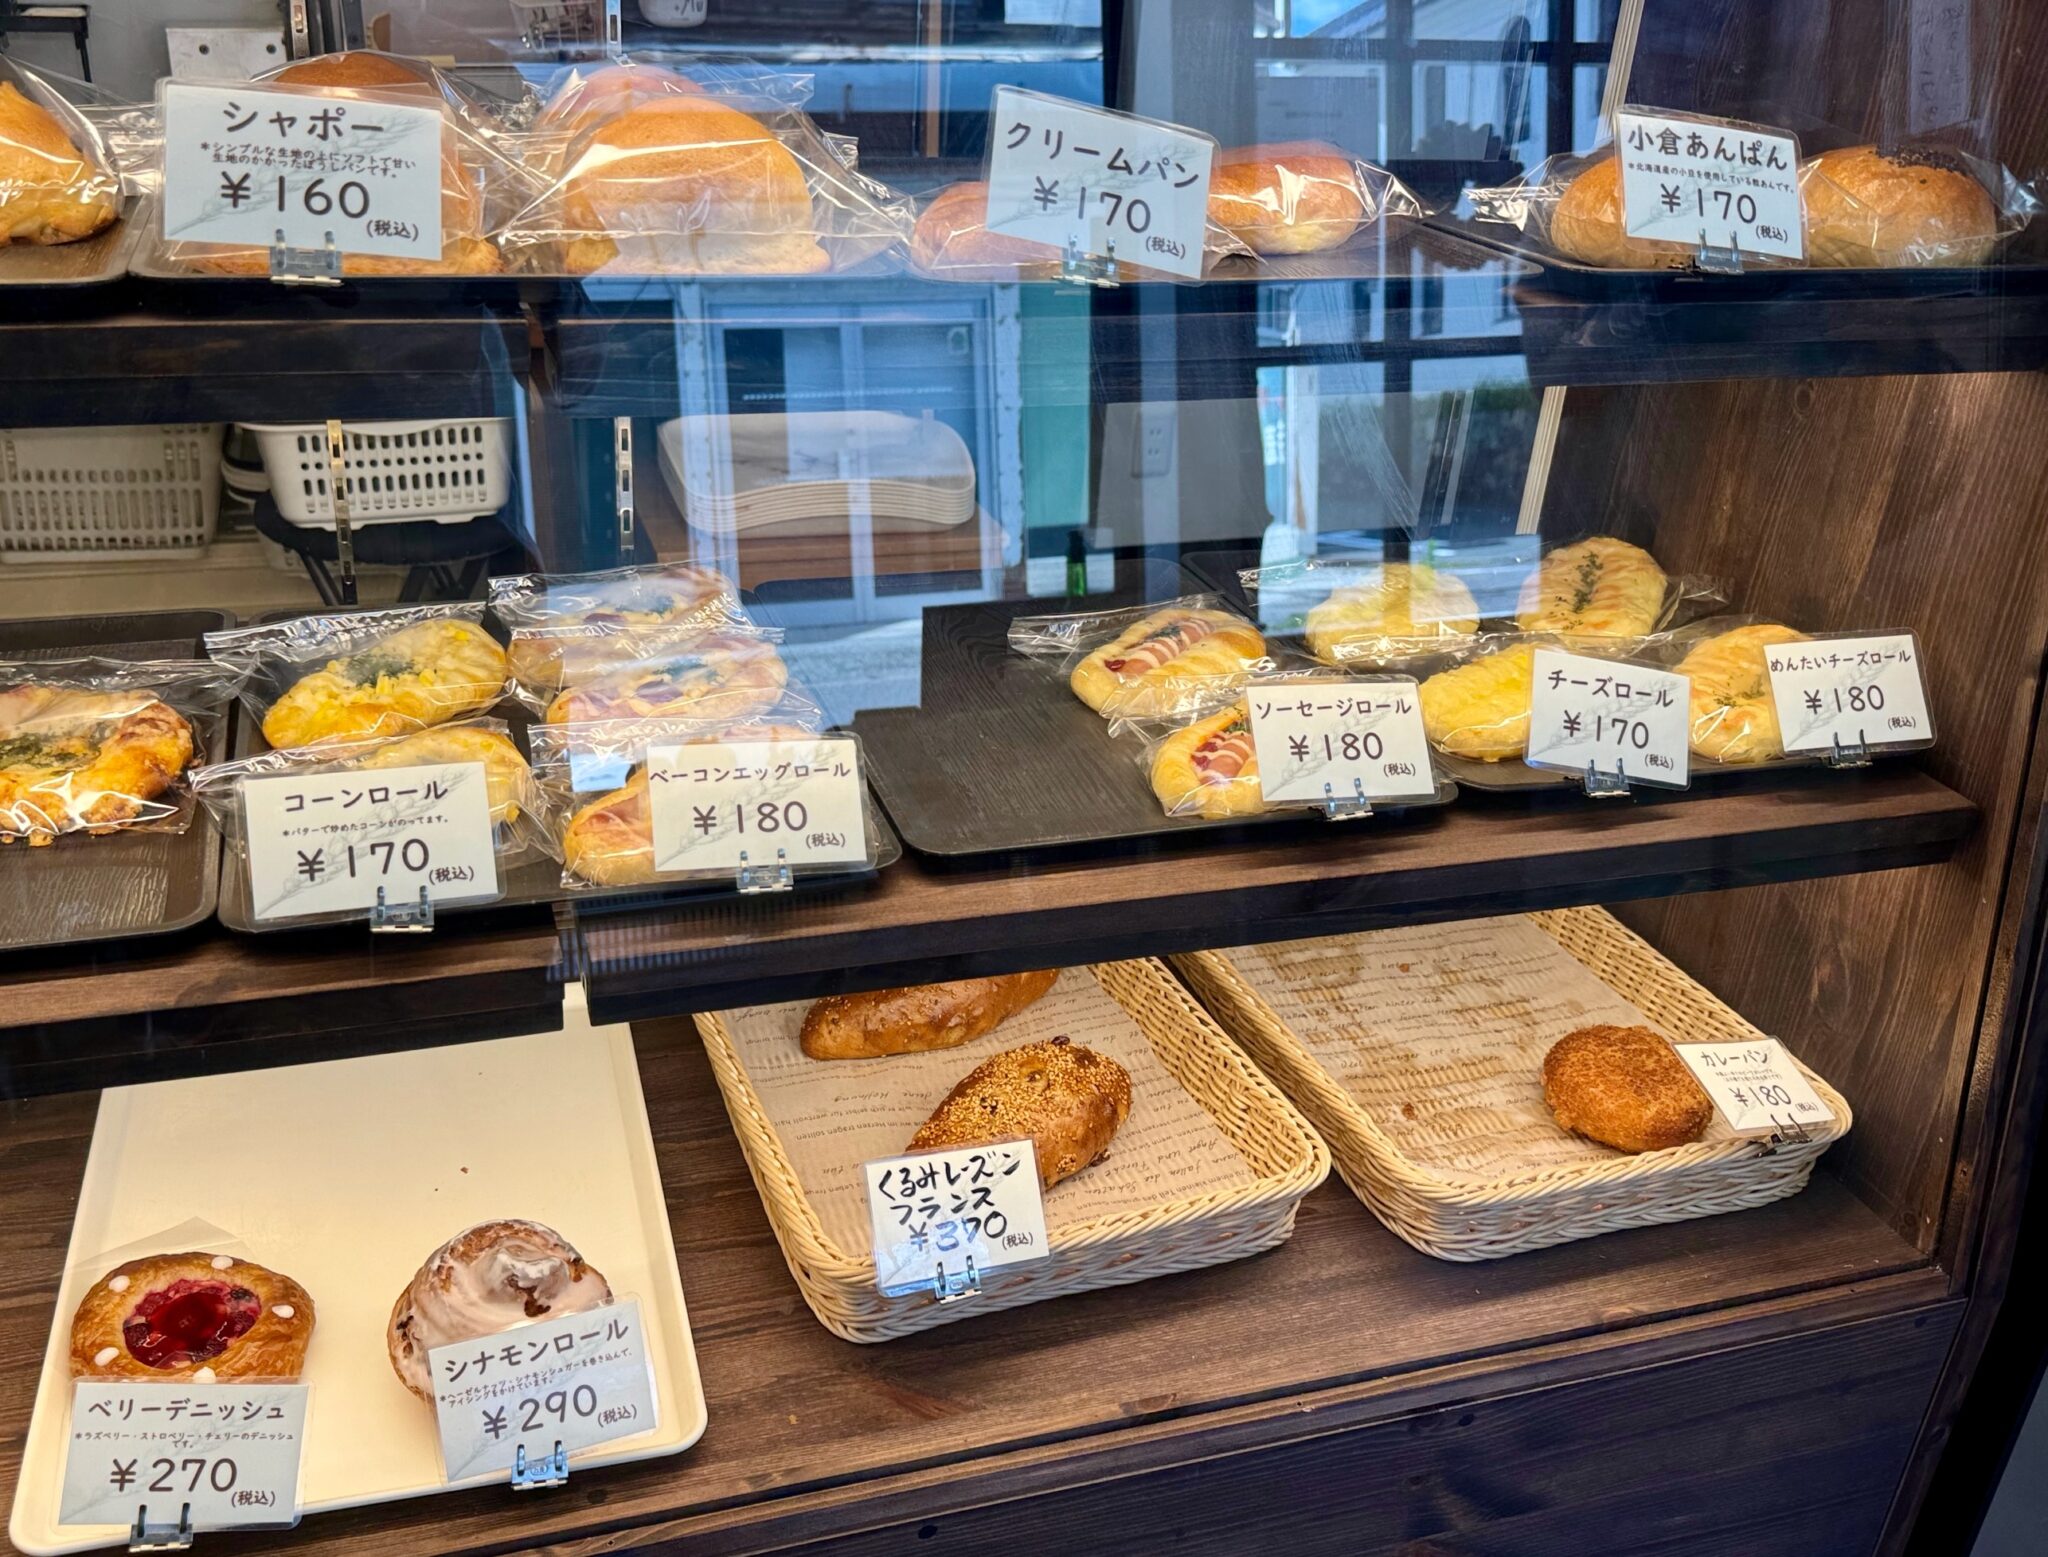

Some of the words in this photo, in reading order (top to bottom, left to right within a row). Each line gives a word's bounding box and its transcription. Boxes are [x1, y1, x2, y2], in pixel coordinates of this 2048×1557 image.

[222, 101, 384, 142] シャポー
[1007, 122, 1199, 188] クリームパン
[1627, 123, 1788, 171] 小倉あんぱん
[220, 170, 370, 219] ¥160
[366, 219, 420, 242] (税込)
[1033, 176, 1151, 234] ¥170
[1145, 235, 1186, 260] (税込)
[1660, 183, 1757, 224] ¥170
[1755, 224, 1789, 243] (税込)
[1770, 650, 1912, 673] めんたいチーズロール
[1255, 697, 1413, 720] ソーセージロール
[1547, 669, 1674, 708] チーズロール
[1803, 684, 1885, 715] ¥180
[1887, 716, 1917, 731] (税込)
[1288, 731, 1384, 763] ¥180
[1383, 762, 1416, 778] (税込)
[1562, 709, 1650, 750] ¥170
[1644, 753, 1675, 771] (税込)
[649, 761, 851, 784] ベーコンエッグロール
[284, 780, 449, 813] コーンロール
[692, 800, 809, 836] ¥180
[805, 832, 847, 849] (税込)
[297, 838, 430, 883] ¥170
[427, 865, 476, 886] (税込)
[1700, 1049, 1768, 1067] カレーパン
[1728, 1084, 1792, 1108] ¥180
[878, 1150, 1021, 1201] くるみレーズン
[889, 1187, 995, 1226] フランス
[908, 1210, 1008, 1252] ¥370
[1001, 1231, 1034, 1251] (税込)
[445, 1319, 629, 1383] シナモンロール
[88, 1396, 286, 1422] ベリーデニッシュ
[481, 1384, 598, 1440] ¥290
[596, 1403, 639, 1429] (税込)
[109, 1457, 239, 1494] ¥270
[231, 1489, 277, 1509] (税込)
